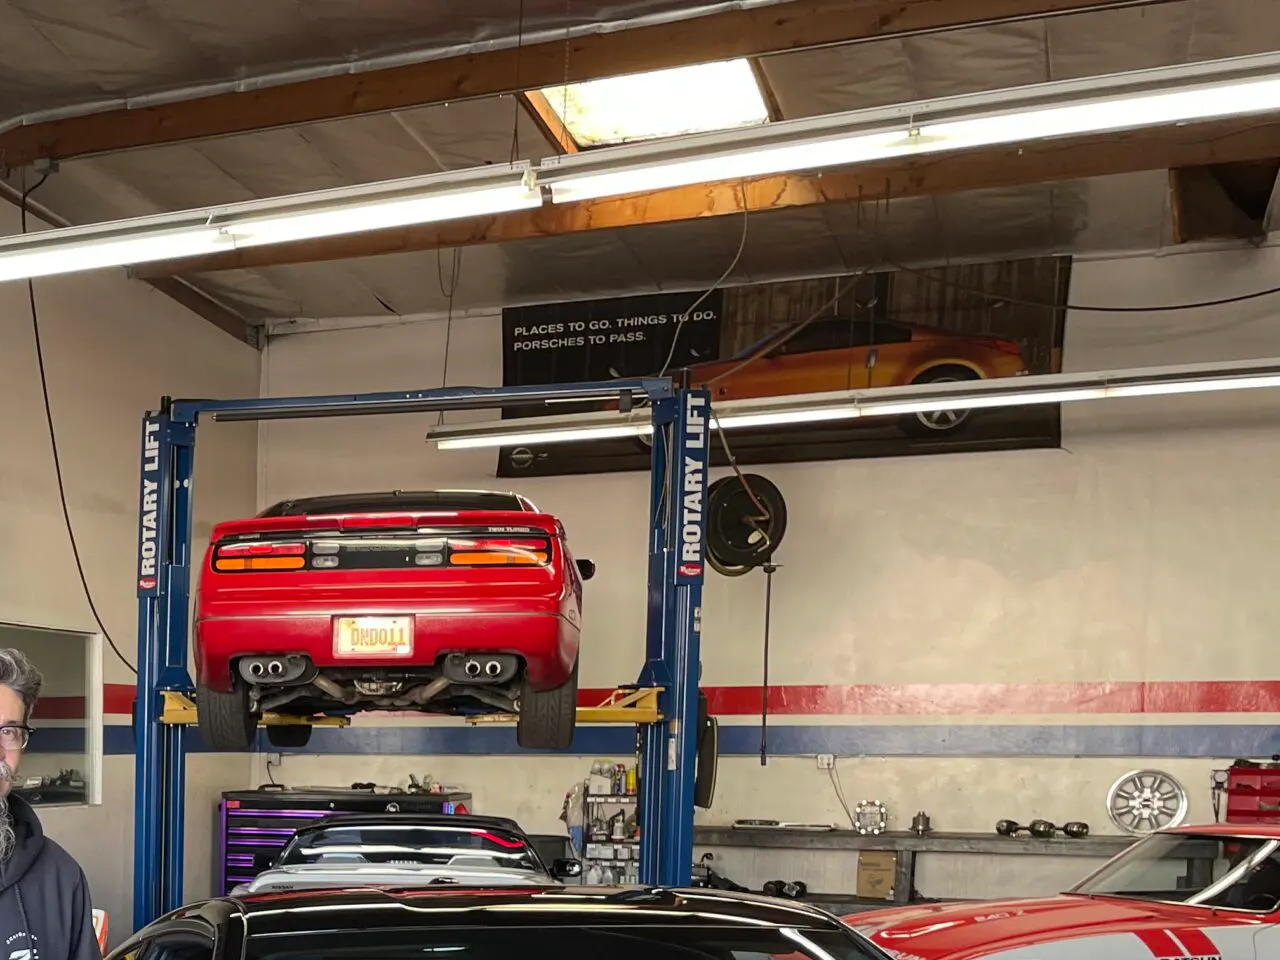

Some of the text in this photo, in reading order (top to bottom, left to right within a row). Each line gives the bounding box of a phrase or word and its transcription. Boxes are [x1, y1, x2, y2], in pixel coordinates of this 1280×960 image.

[514, 310, 717, 336] PLACES TO GO. THINGS TO DO.
[514, 331, 647, 351] PORSCHES TO PASS.
[141, 420, 160, 576] ROTARY LIFT
[682, 393, 705, 562] ROTARY LIFT
